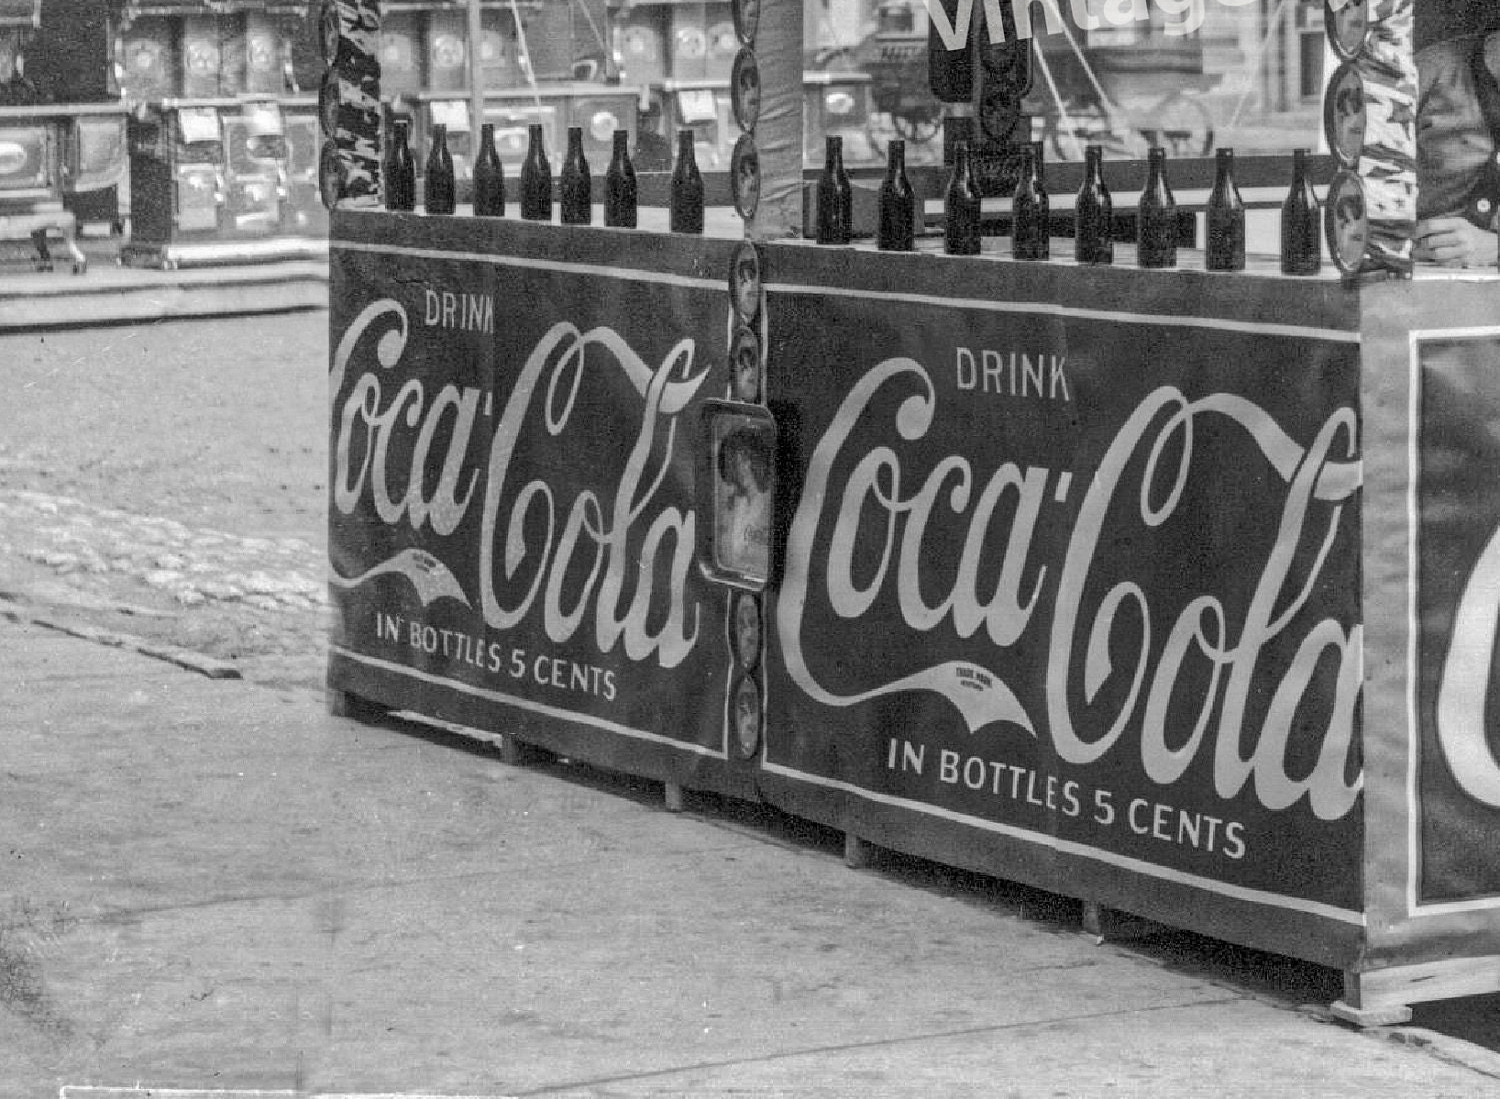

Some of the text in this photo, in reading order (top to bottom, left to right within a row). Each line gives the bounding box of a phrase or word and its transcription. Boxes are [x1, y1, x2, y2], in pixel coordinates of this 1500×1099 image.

[425, 288, 494, 334] DRINK
[956, 346, 1070, 402] DRINK
[376, 612, 617, 701] IN BOTTLES 5 CENTS
[888, 737, 1247, 861] IN BOTTLES 5 CENTS
